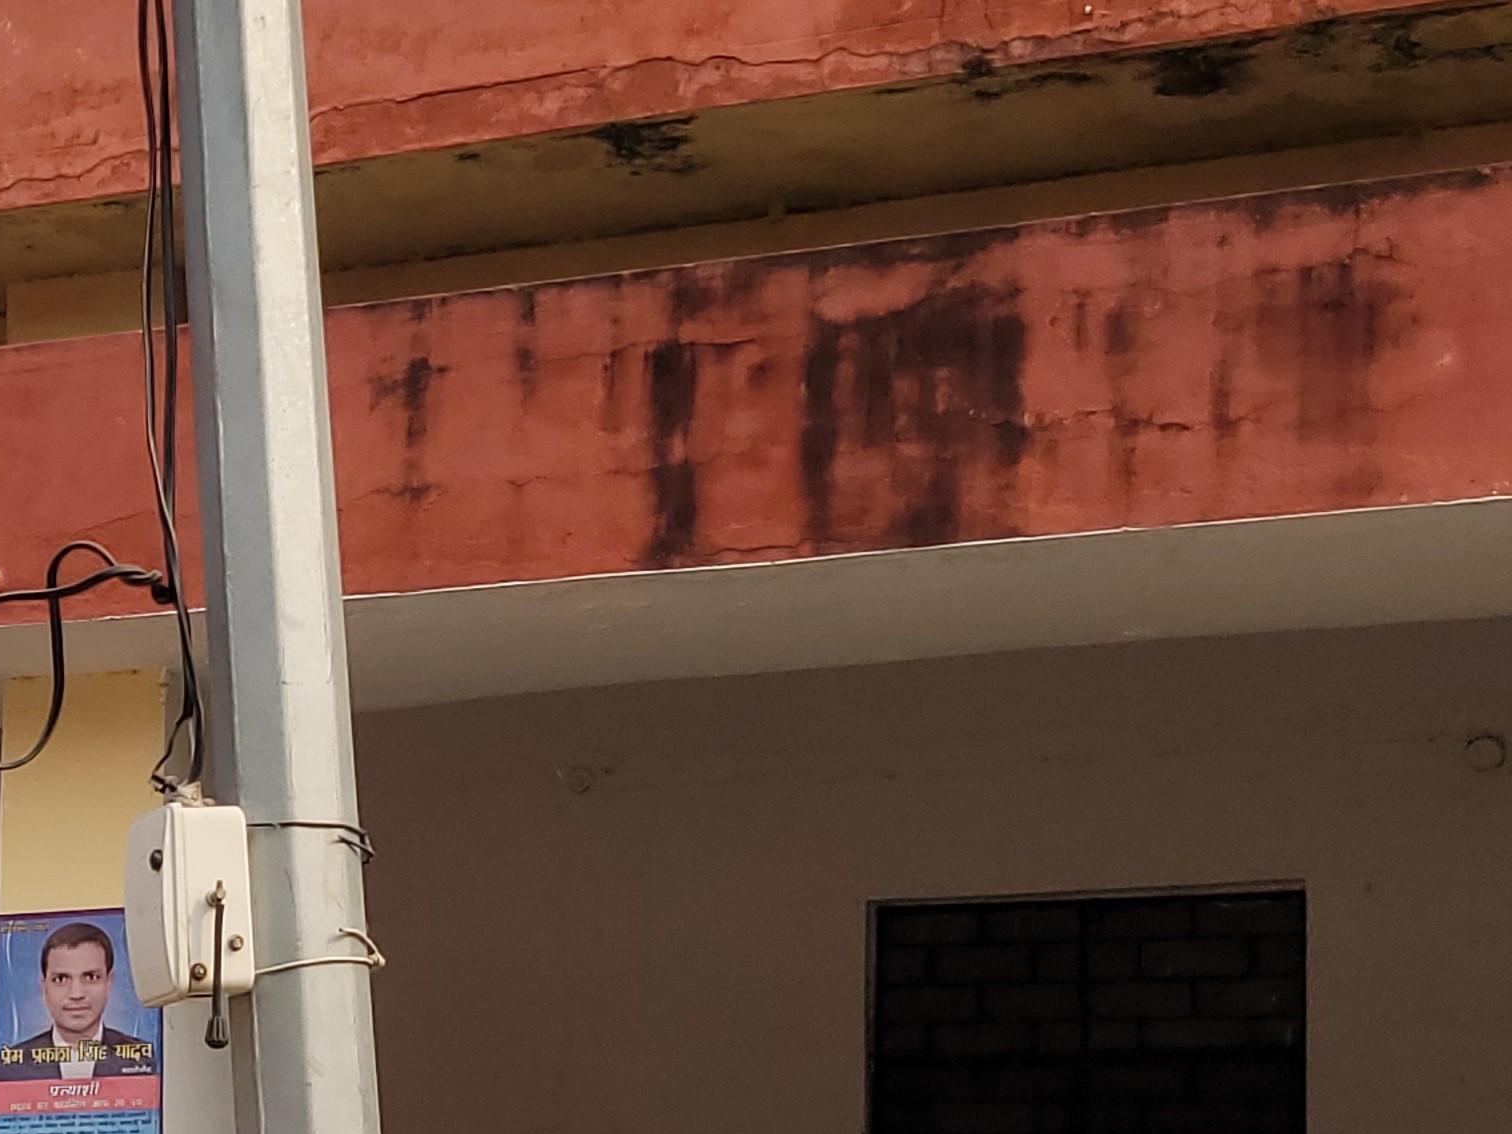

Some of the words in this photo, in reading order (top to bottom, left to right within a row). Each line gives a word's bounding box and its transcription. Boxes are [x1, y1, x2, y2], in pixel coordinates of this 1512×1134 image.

[0, 1045, 24, 1065] प्रेम
[31, 1045, 72, 1065] प्रकाश
[114, 1041, 153, 1062] यादव
[49, 1081, 100, 1097] प्रत्याशी
